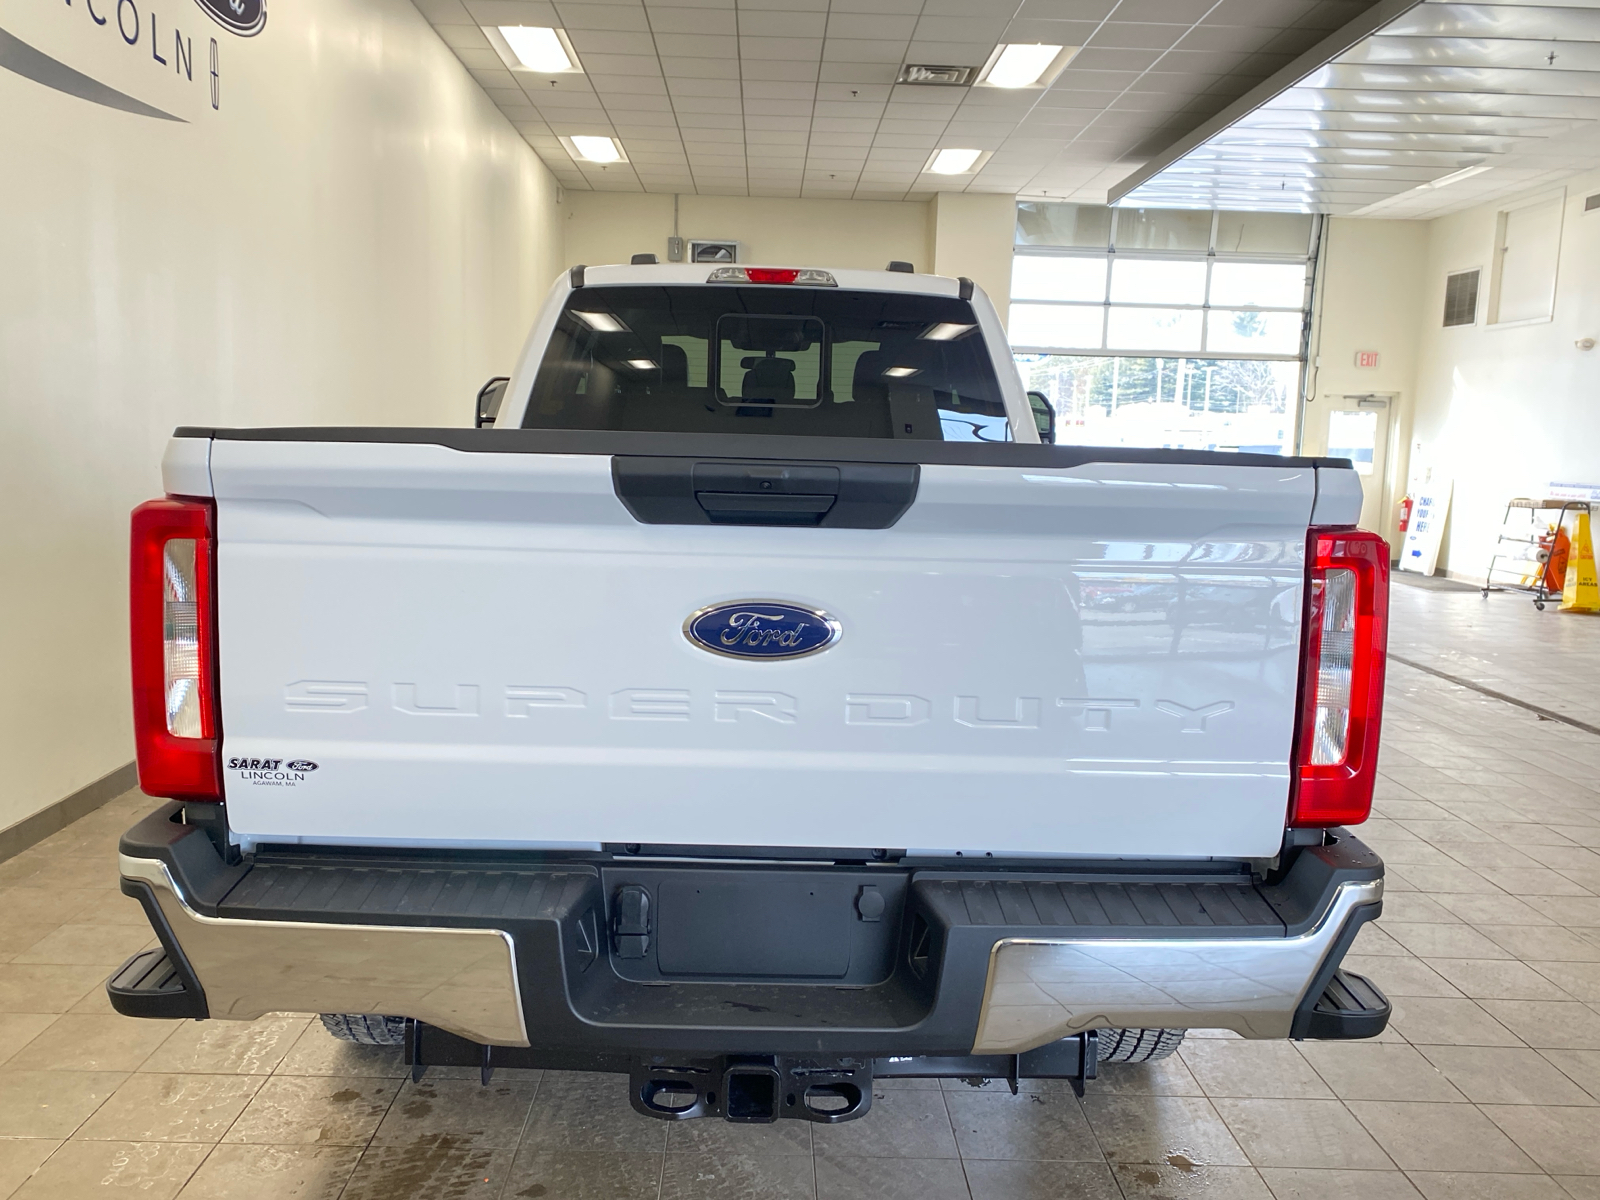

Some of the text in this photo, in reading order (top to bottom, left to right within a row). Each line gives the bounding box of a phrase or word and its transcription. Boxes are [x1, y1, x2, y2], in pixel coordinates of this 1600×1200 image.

[1360, 351, 1378, 367] EXIT
[719, 611, 810, 648] Ford
[284, 679, 1236, 734] SUPER DUTY
[227, 757, 283, 771] SARAT
[241, 771, 305, 781] LINCOLN
